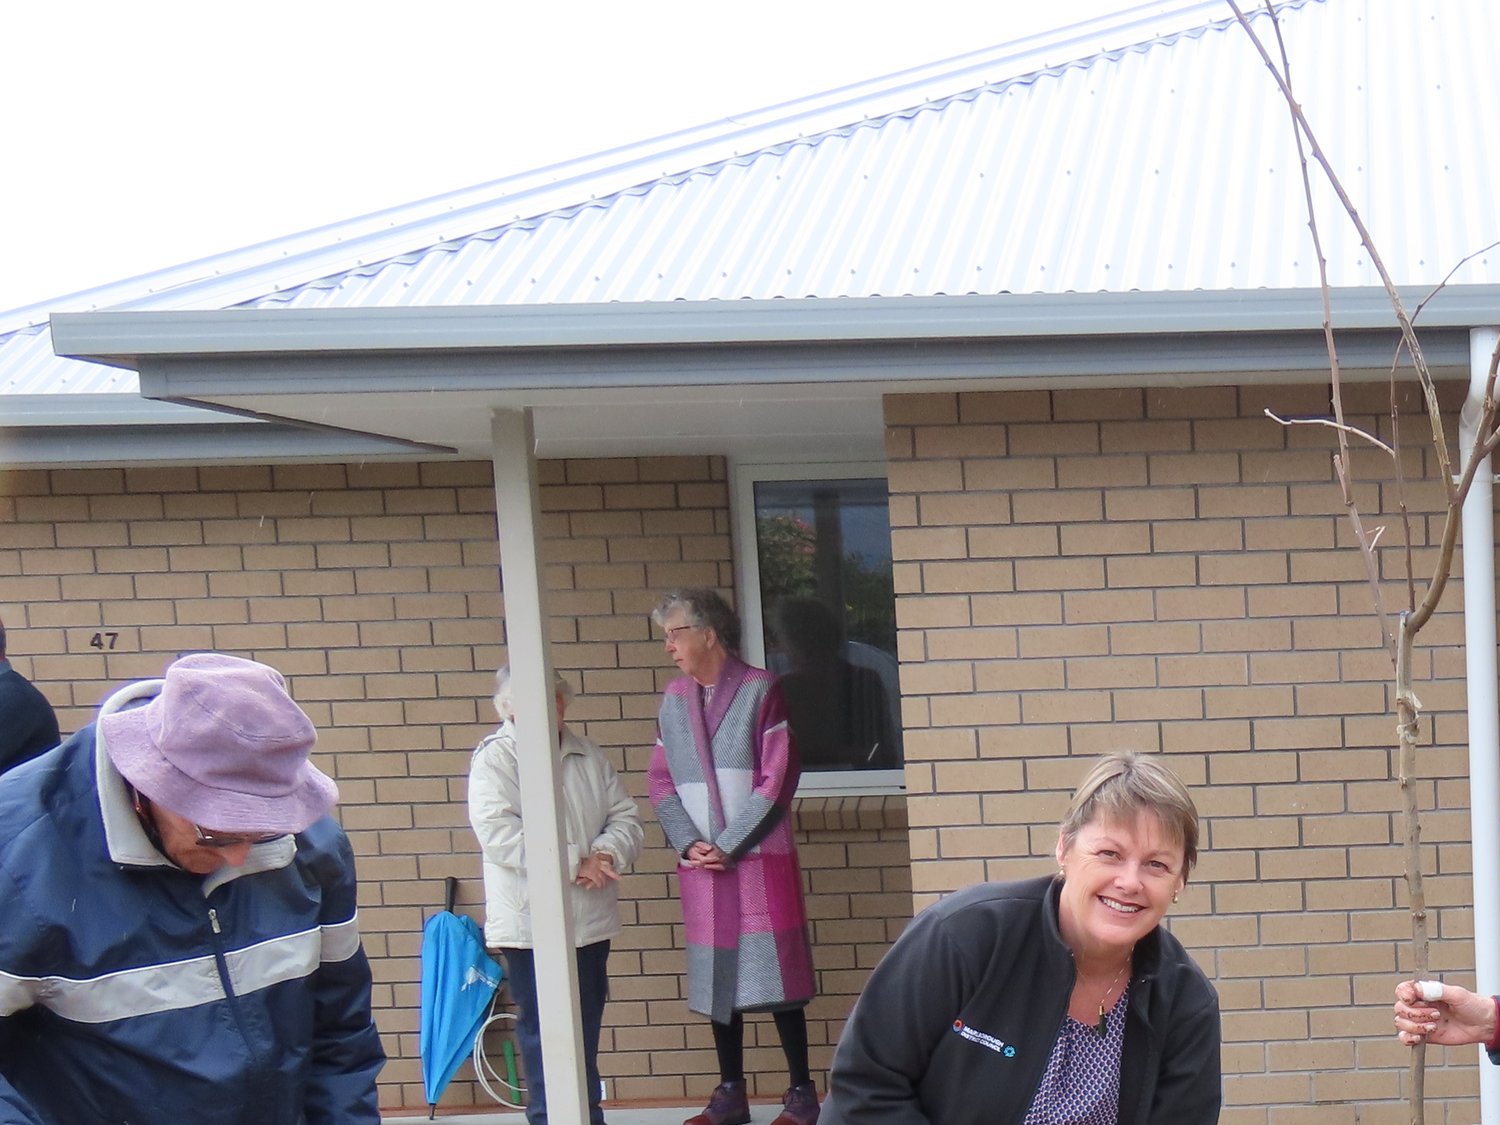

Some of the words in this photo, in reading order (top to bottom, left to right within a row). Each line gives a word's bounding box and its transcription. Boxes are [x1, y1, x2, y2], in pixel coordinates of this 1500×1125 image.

[90, 632, 119, 650] 47
[962, 1024, 1005, 1048] MARLBOROUGH
[980, 1039, 1001, 1053] COUNCIL
